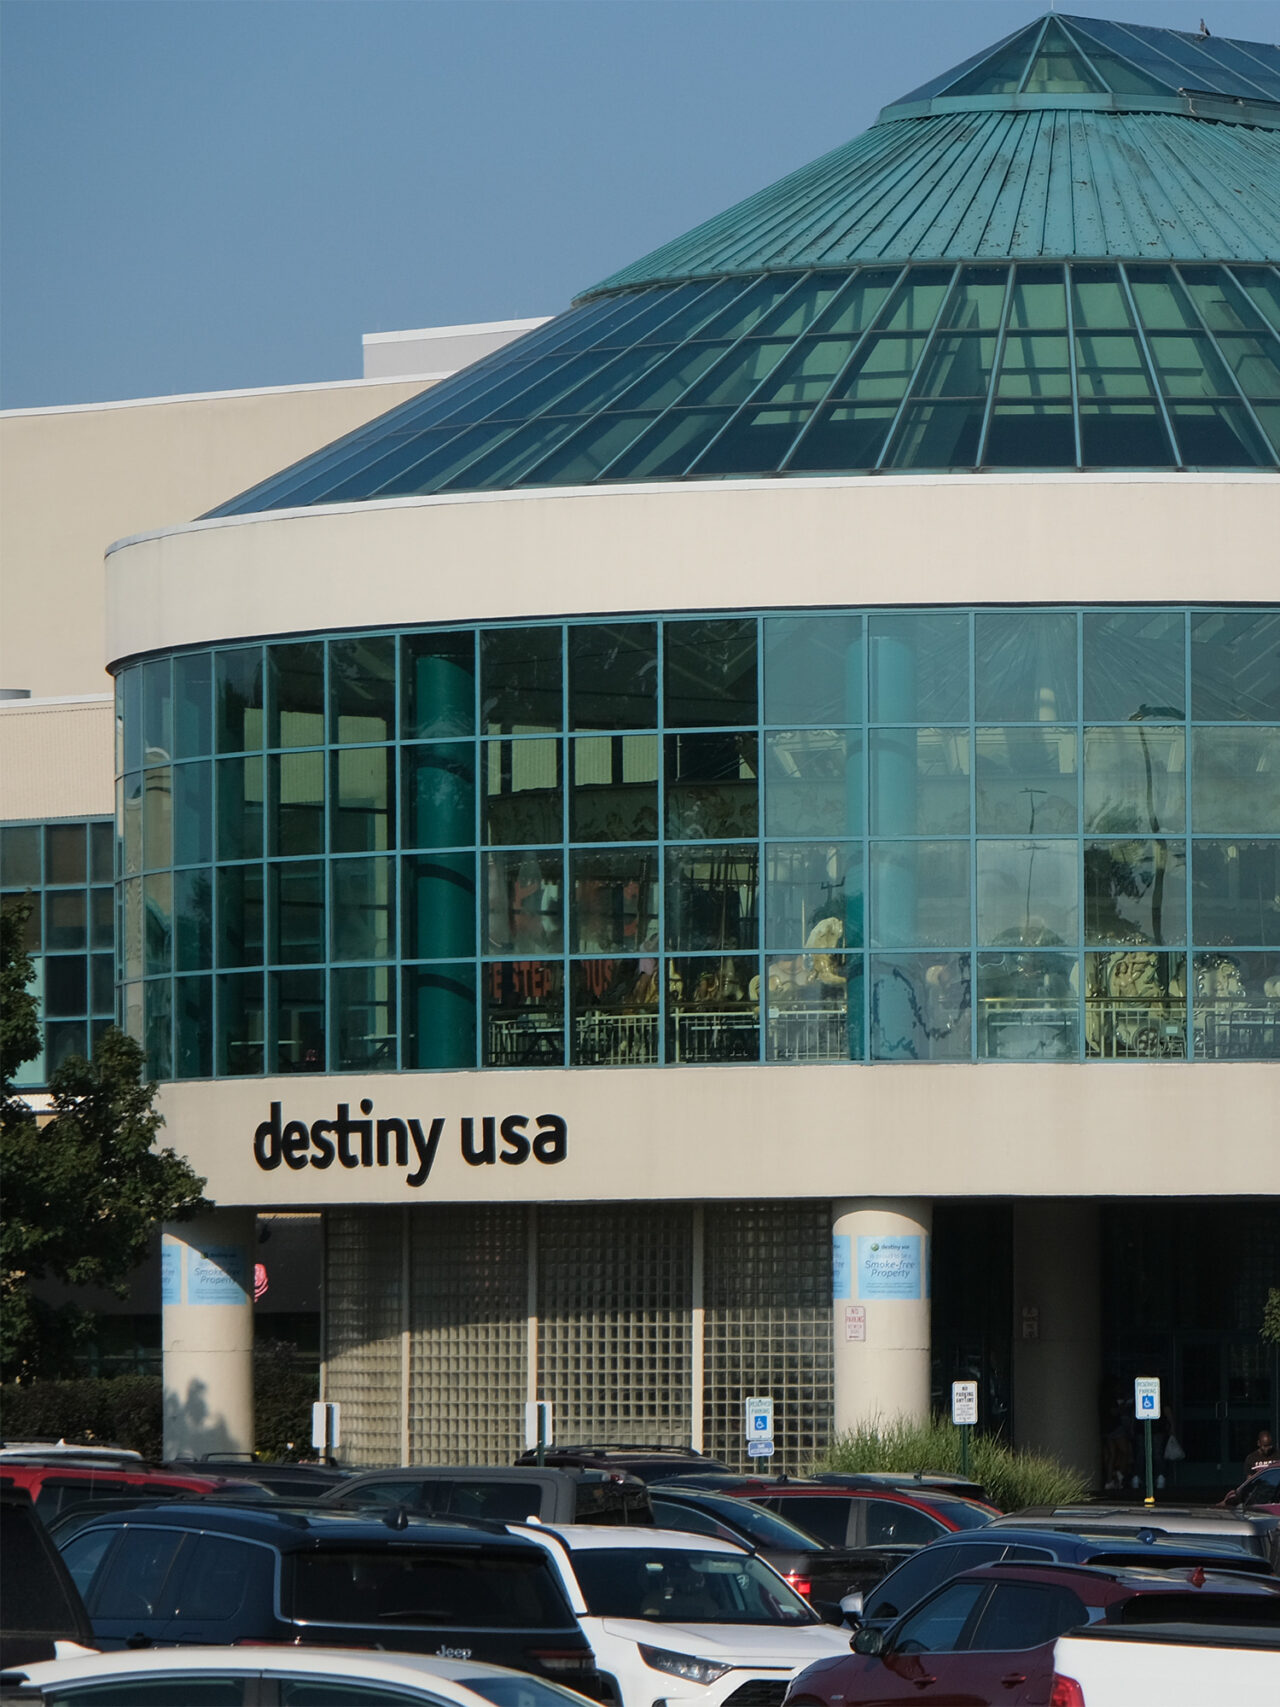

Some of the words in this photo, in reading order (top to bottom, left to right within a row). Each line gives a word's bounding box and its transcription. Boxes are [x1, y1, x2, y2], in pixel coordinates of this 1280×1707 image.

[254, 1098, 445, 1187] destiny
[460, 1114, 568, 1166] usa
[865, 1260, 916, 1270] Smoke-free
[871, 1269, 911, 1278] Property
[436, 1645, 472, 1661] Jeep
